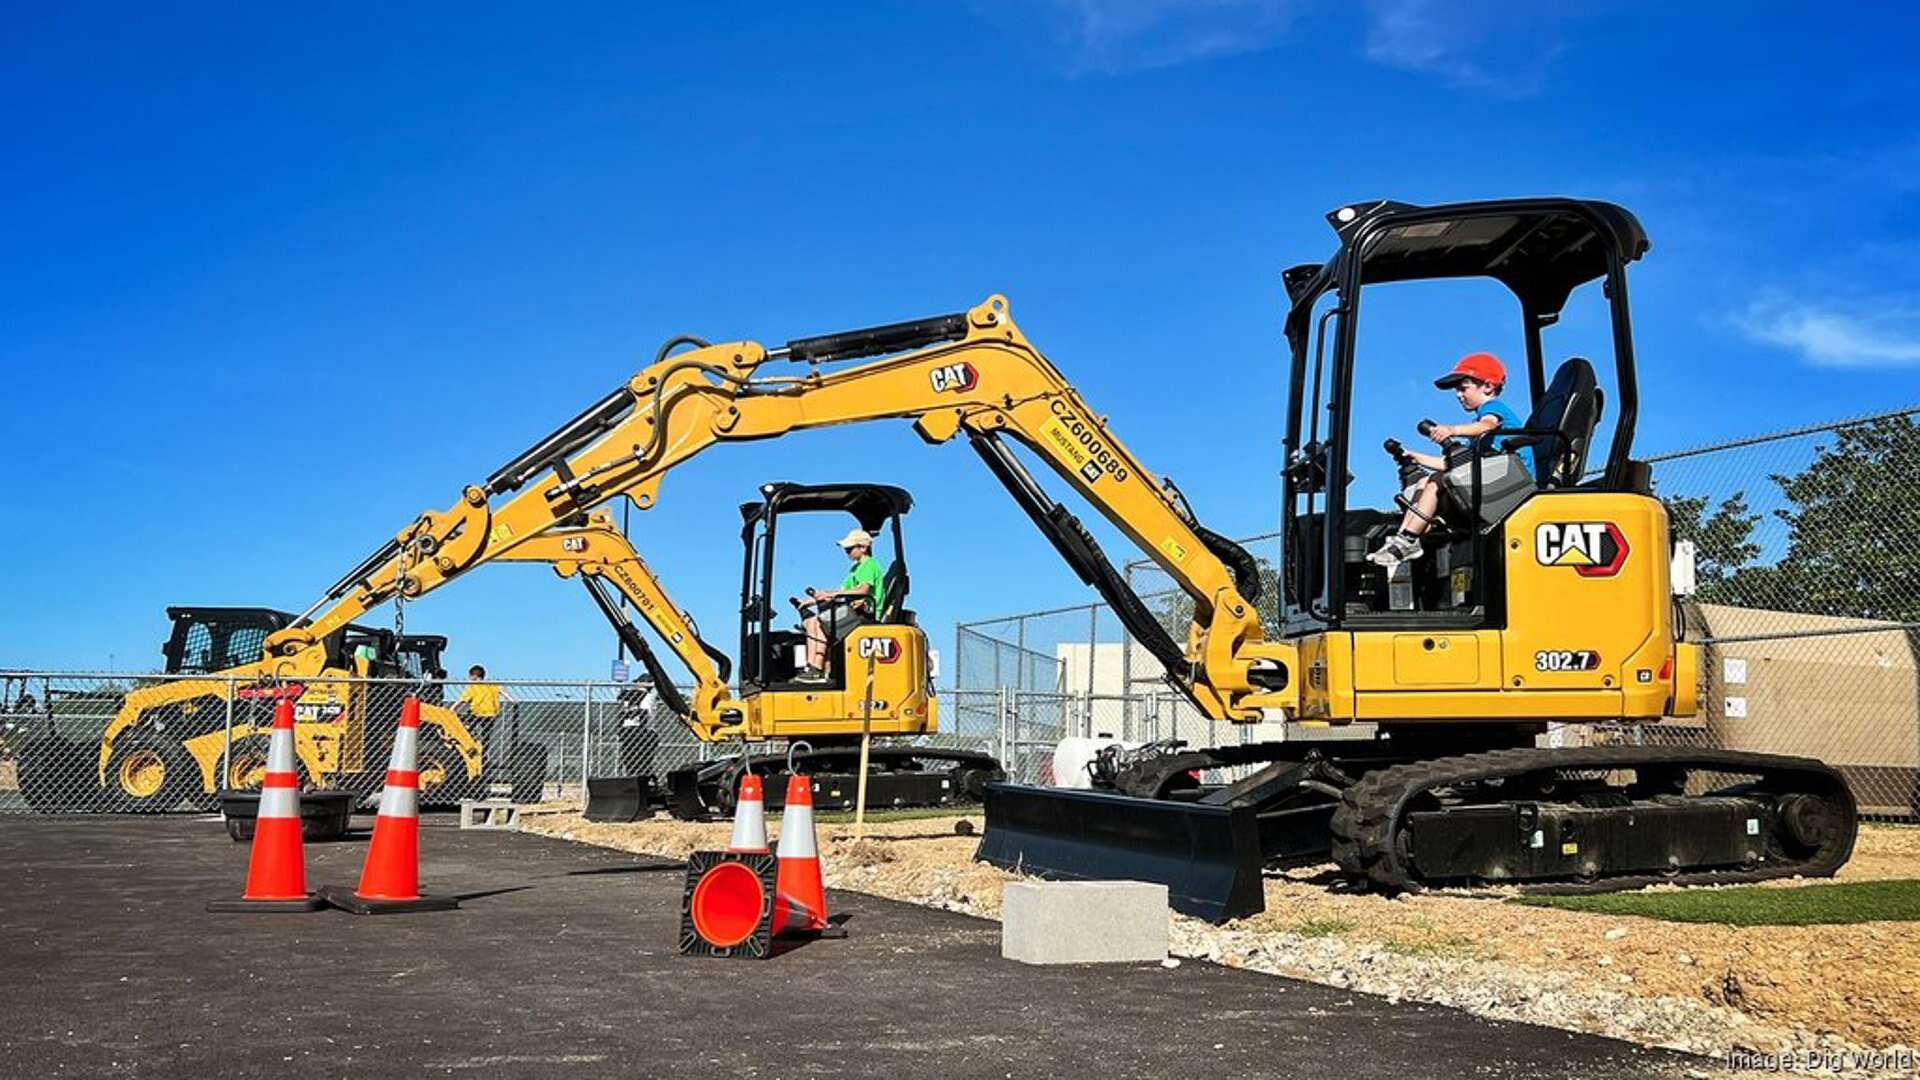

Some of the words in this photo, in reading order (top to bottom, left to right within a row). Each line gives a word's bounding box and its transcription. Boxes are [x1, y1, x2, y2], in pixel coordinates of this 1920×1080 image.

[930, 362, 967, 392] CAT
[1051, 399, 1128, 483] CZ600689
[1051, 427, 1085, 464] MUSTANG
[563, 537, 585, 551] CAT
[1536, 523, 1606, 566] CAT
[859, 638, 892, 658] CAT
[1535, 651, 1592, 671] 302.7
[294, 705, 318, 721] CAT
